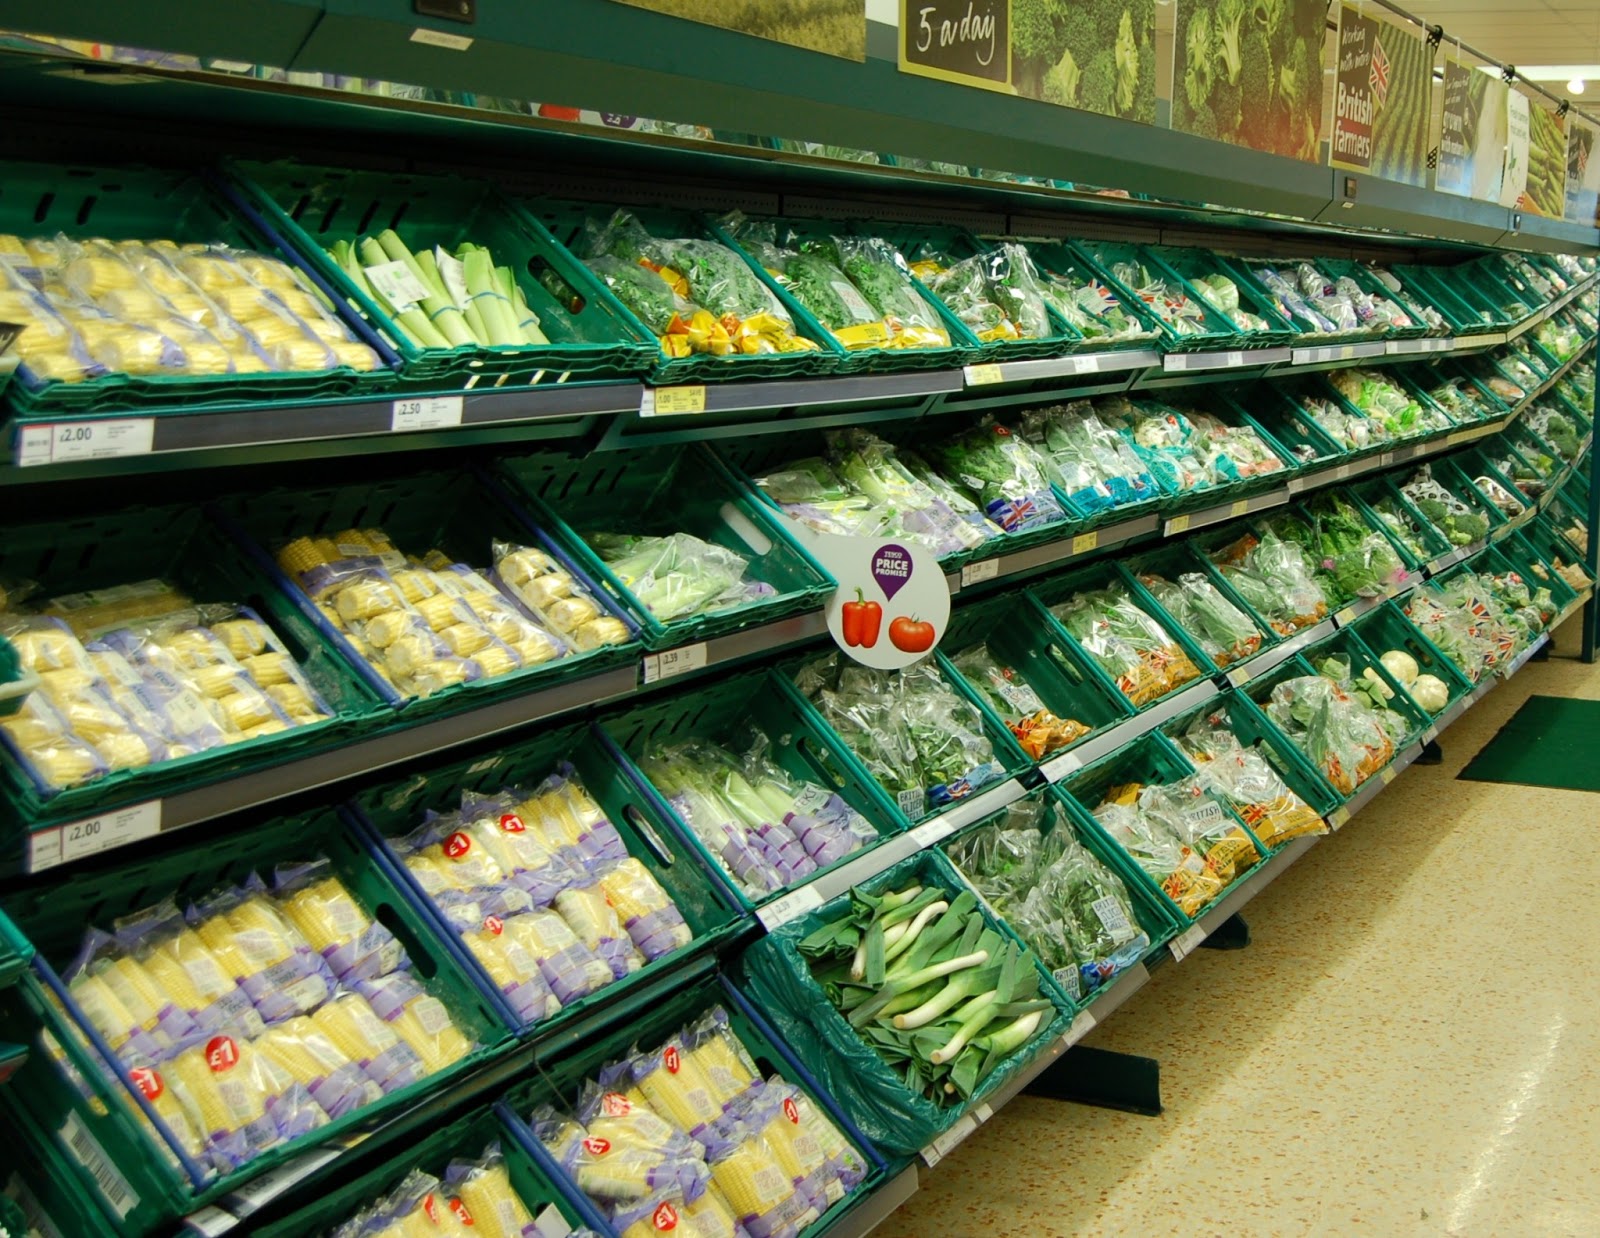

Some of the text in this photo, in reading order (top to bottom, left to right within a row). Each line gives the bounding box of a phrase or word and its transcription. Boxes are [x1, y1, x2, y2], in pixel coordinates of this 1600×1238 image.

[916, 1, 995, 66] 5 a day
[1337, 81, 1373, 126] British
[1334, 119, 1371, 159] farmers
[60, 427, 92, 443] £2.00
[875, 568, 908, 577] PROMISE
[876, 558, 909, 570] PRICE
[69, 821, 102, 842] £2.00
[504, 816, 524, 830] £1
[448, 834, 468, 856] £1
[209, 1039, 235, 1067] £1
[667, 1052, 678, 1069] £1
[785, 1101, 797, 1121] £1
[655, 1205, 675, 1229] £1
